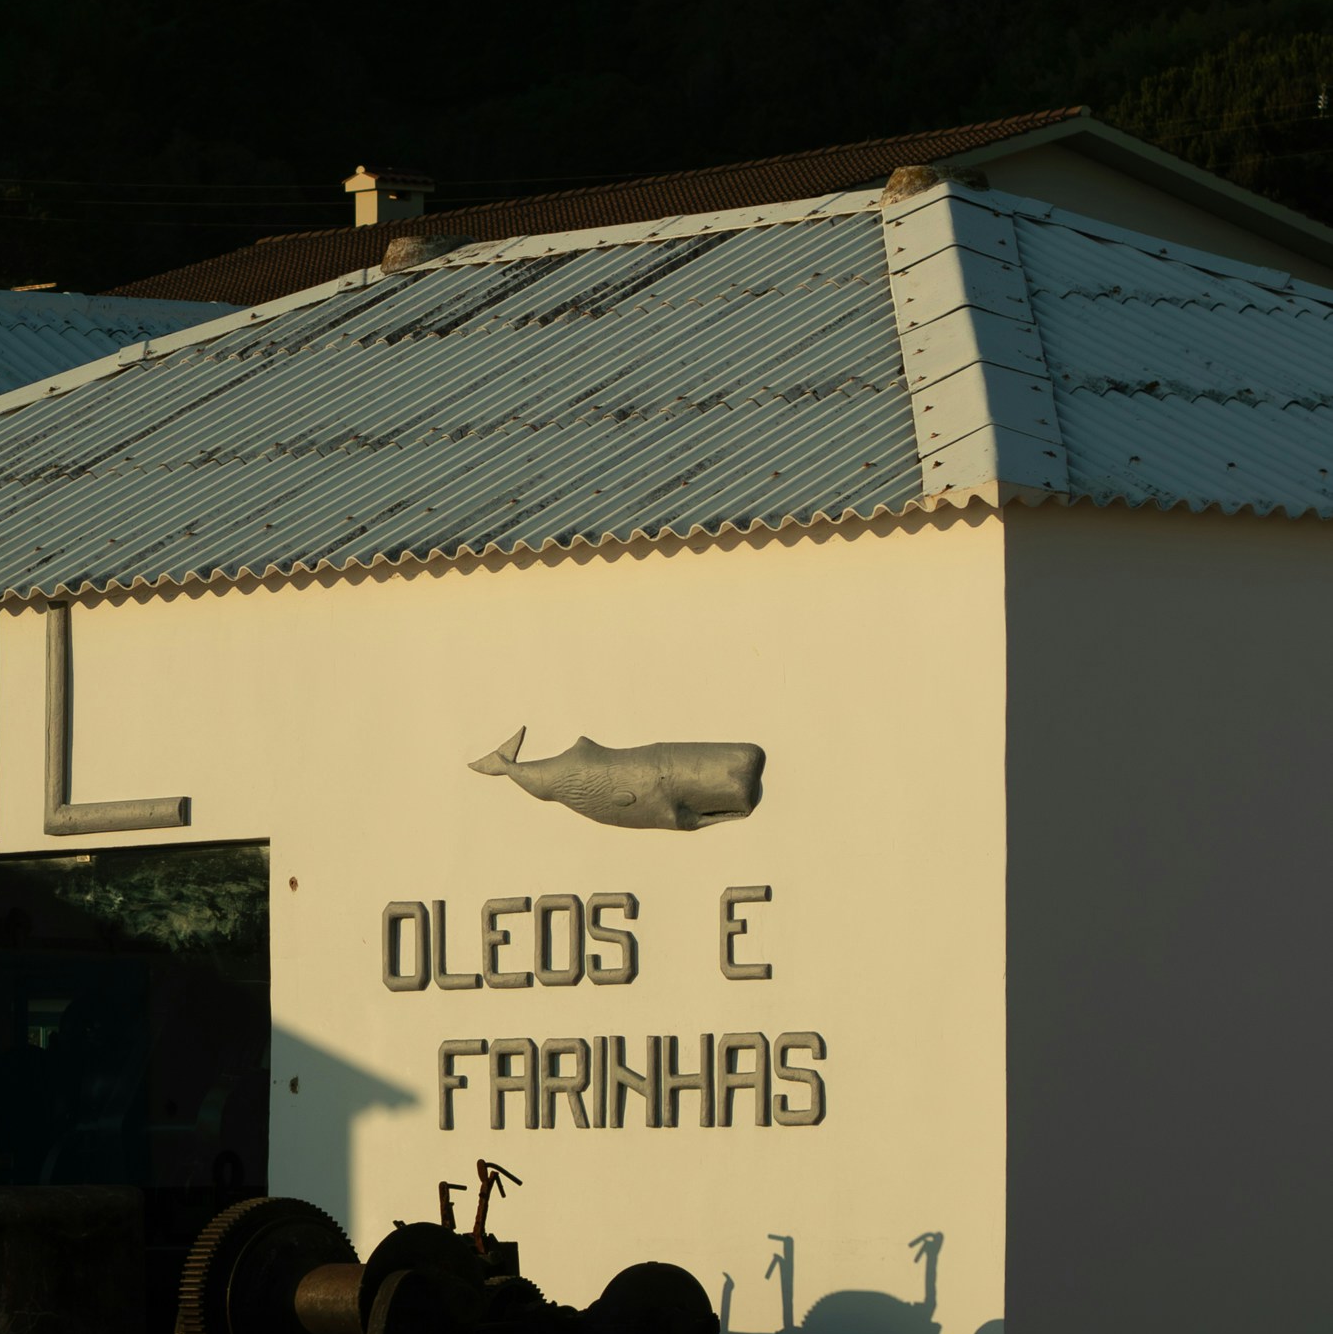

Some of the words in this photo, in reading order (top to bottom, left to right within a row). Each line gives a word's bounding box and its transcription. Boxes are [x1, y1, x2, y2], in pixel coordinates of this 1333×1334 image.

[382, 892, 640, 992] OLEOS
[719, 885, 773, 981] E
[438, 1031, 827, 1131] FARINHAS
